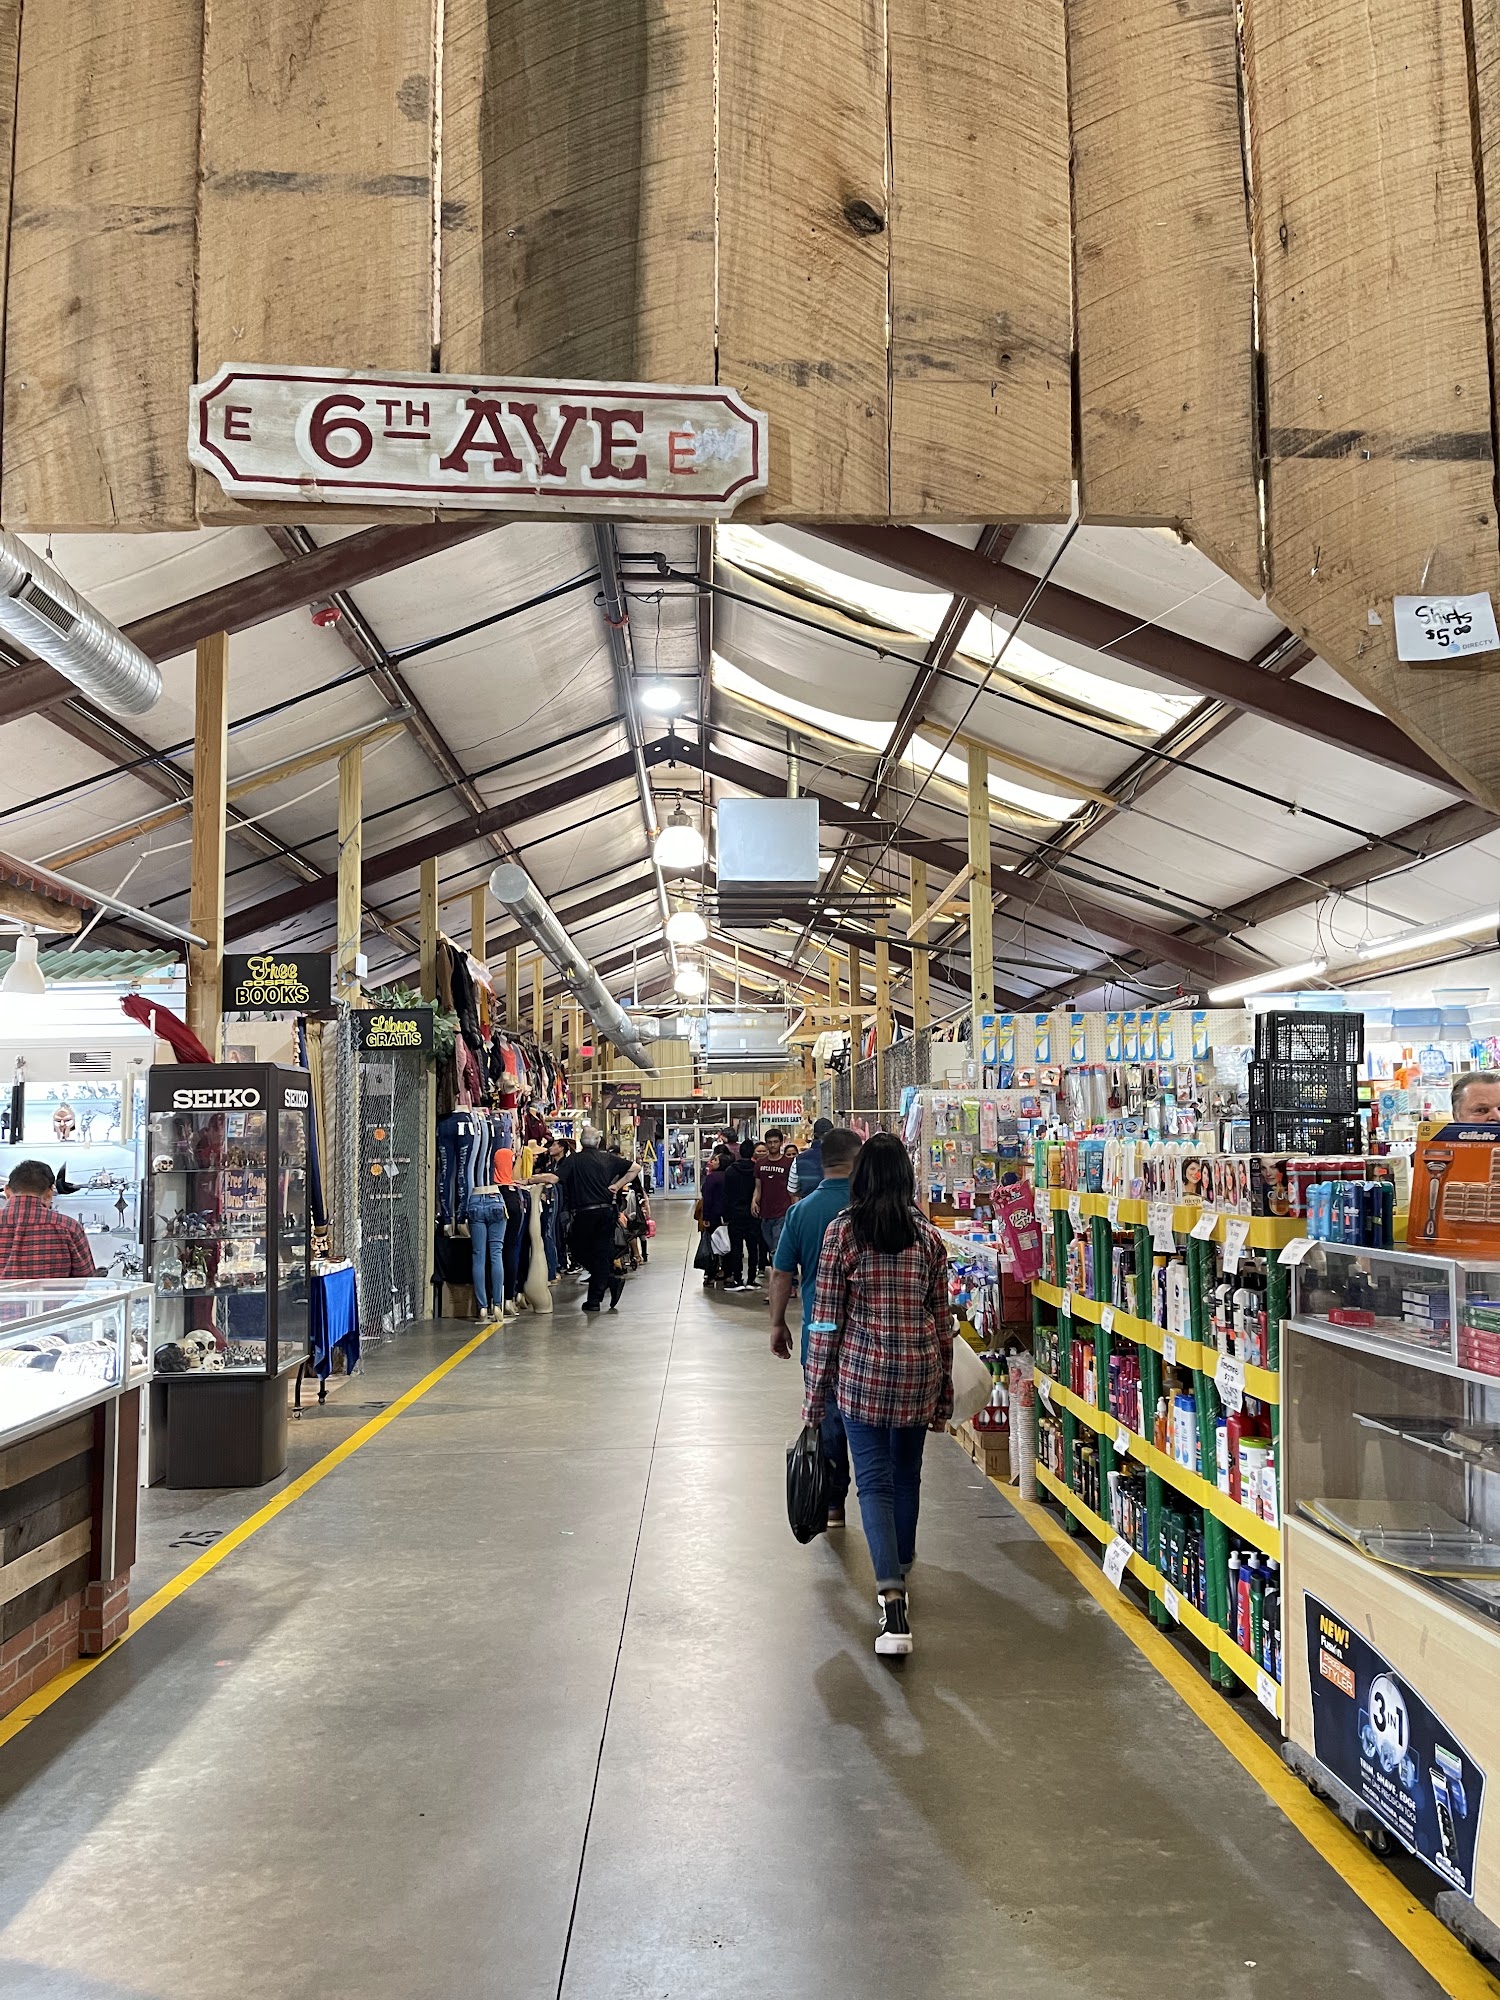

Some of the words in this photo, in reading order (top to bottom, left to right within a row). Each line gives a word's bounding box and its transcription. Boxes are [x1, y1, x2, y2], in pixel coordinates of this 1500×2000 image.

[224, 405, 252, 442] E
[308, 394, 431, 469] 6TH
[438, 398, 648, 482] AVE
[1414, 604, 1473, 625] Shirts
[1462, 638, 1494, 650] DIRECTV
[247, 955, 298, 980] Free
[243, 979, 302, 987] GOSPEL
[235, 986, 310, 1005] BOOKS
[370, 1014, 418, 1033] Libros
[365, 1032, 422, 1047] GRATIS
[173, 1088, 261, 1109] SEIKO
[284, 1088, 309, 1109] SEIKO
[761, 1099, 803, 1114] PERFUMES
[1319, 1614, 1350, 1650] NEW!
[1321, 1664, 1355, 1696] STYLER
[1373, 1691, 1387, 1733] 3
[1387, 1714, 1397, 1730] IN
[1396, 1705, 1404, 1748] 1
[1376, 1771, 1399, 1798] SHAVE,
[1399, 1790, 1417, 1812] EDGE
